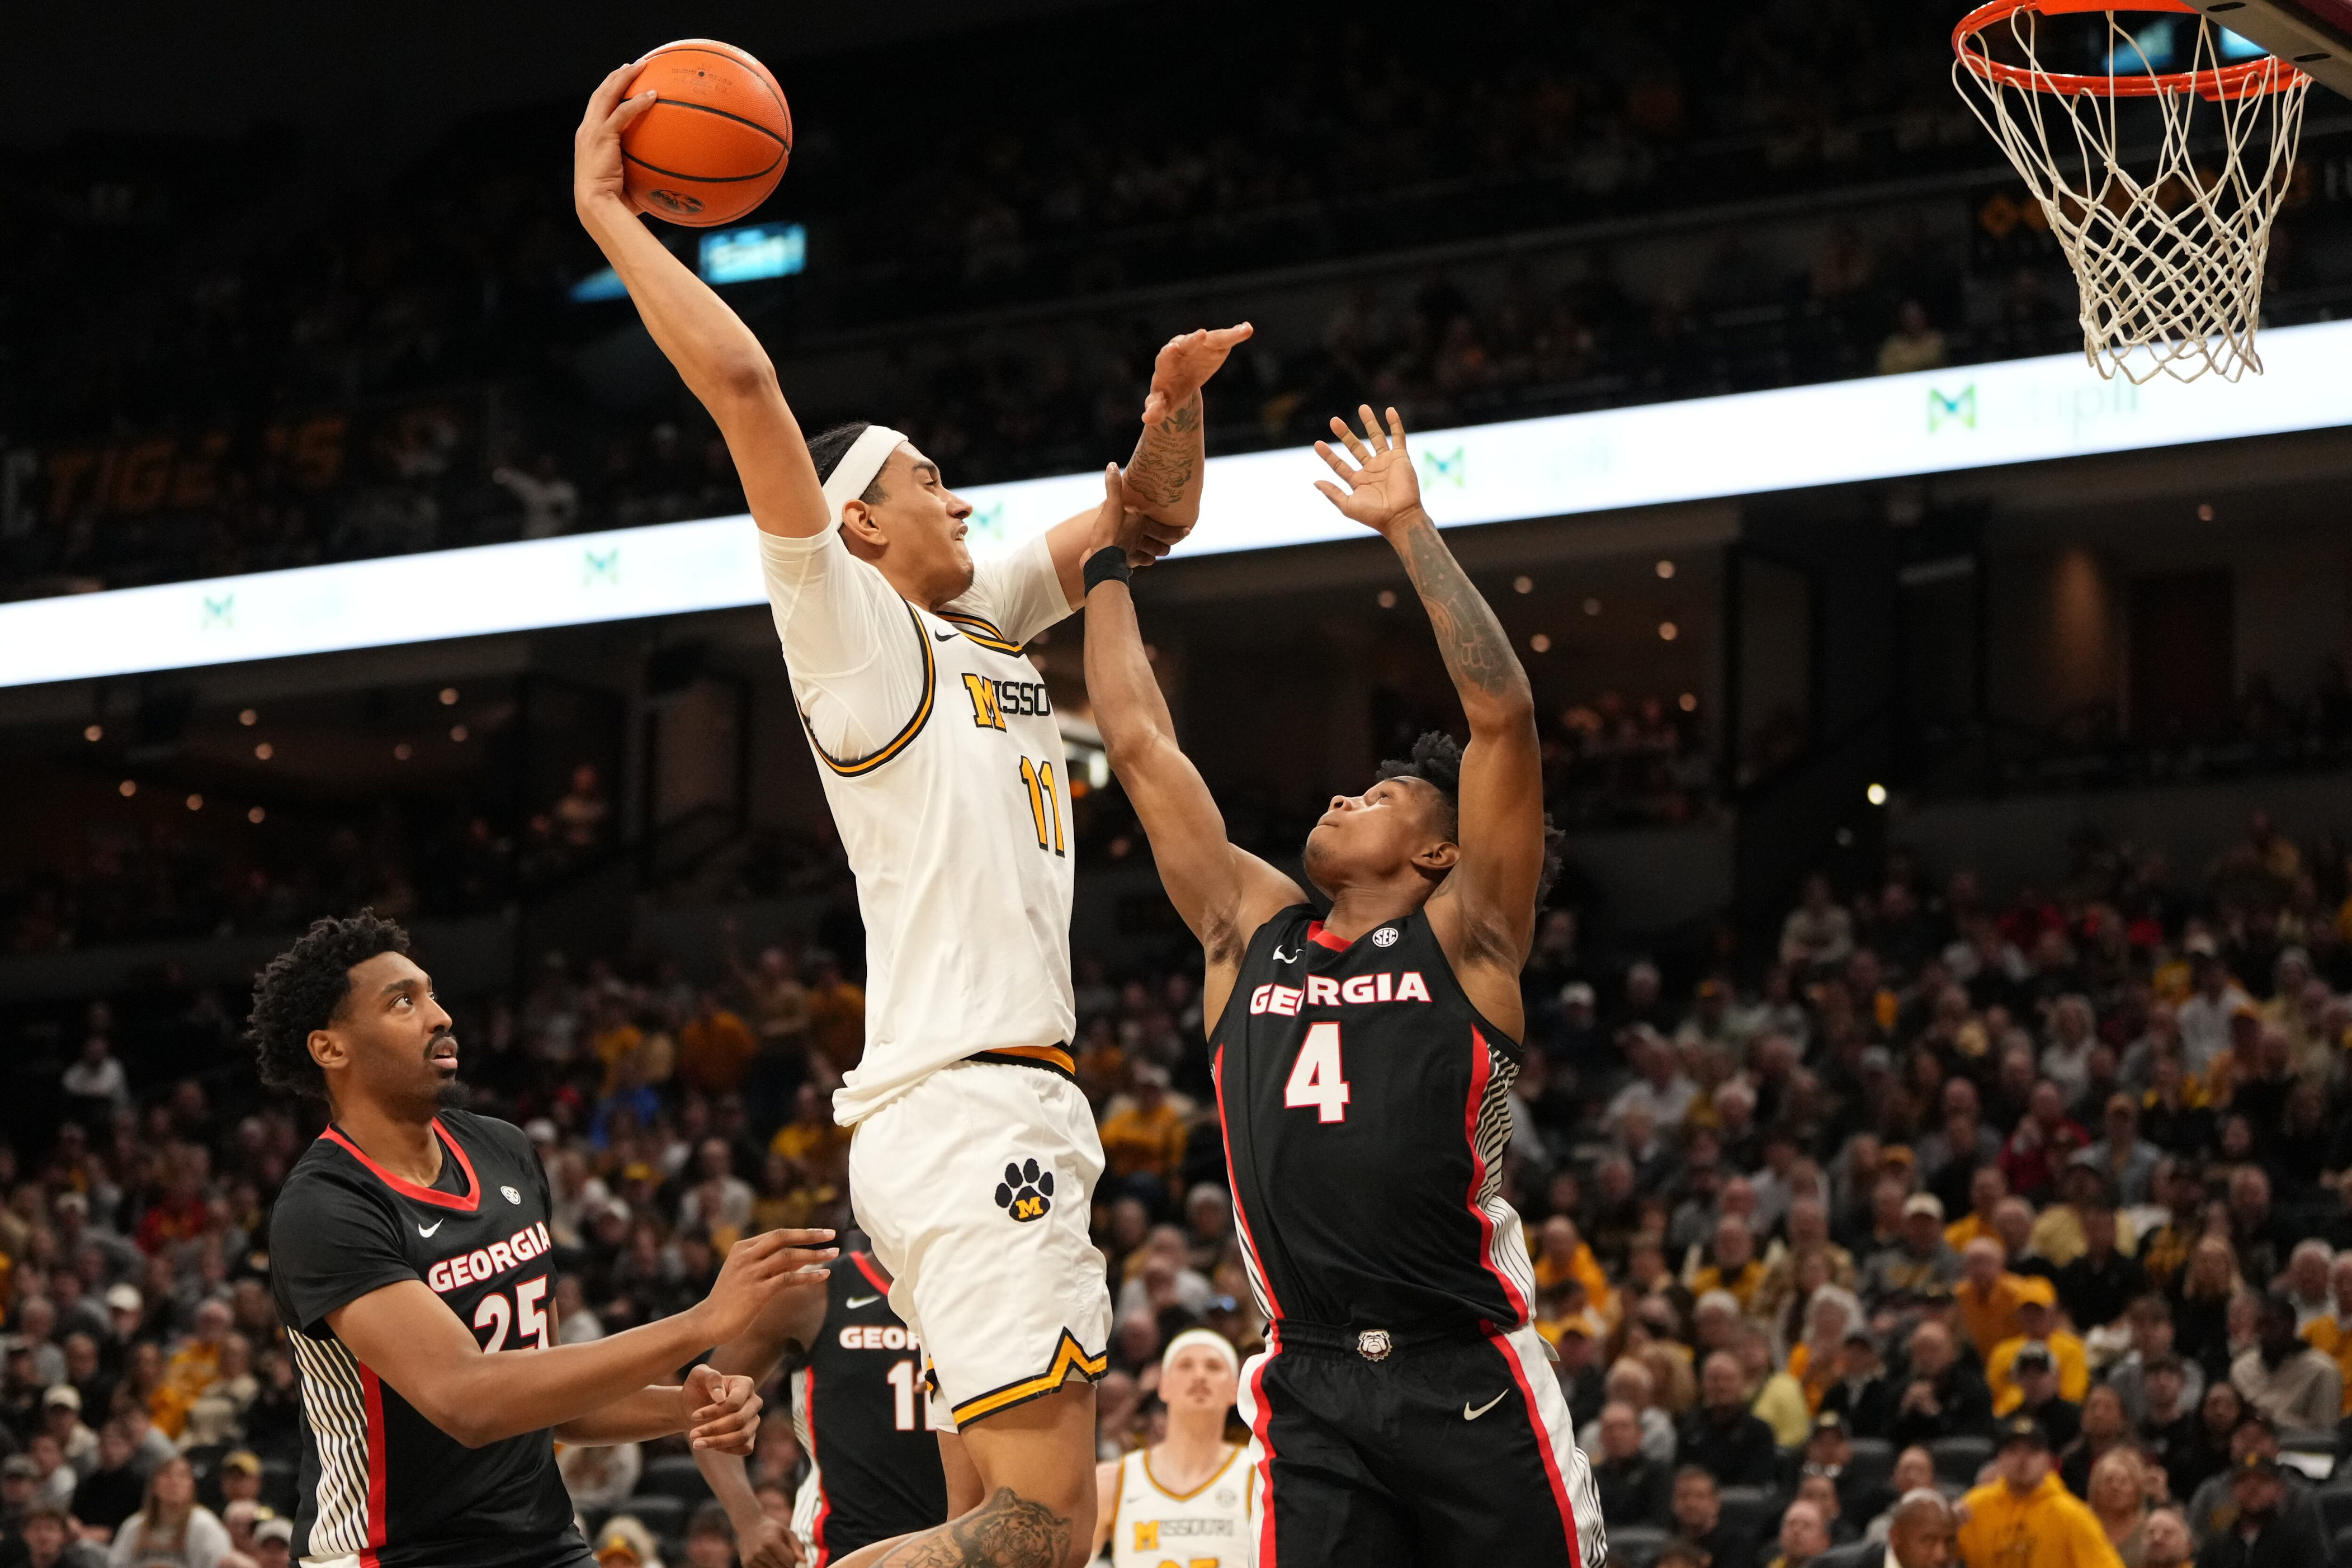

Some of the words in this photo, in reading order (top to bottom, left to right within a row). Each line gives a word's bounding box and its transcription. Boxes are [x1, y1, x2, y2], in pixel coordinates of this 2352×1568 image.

[46, 417, 346, 520] TIGES
[1019, 755, 1065, 858] 11
[1374, 929, 1397, 946] SEC
[1284, 1021, 1350, 1123] 4
[1016, 1197, 1043, 1218] M
[428, 1221, 551, 1293] GEORGIA
[474, 1274, 550, 1354] 25
